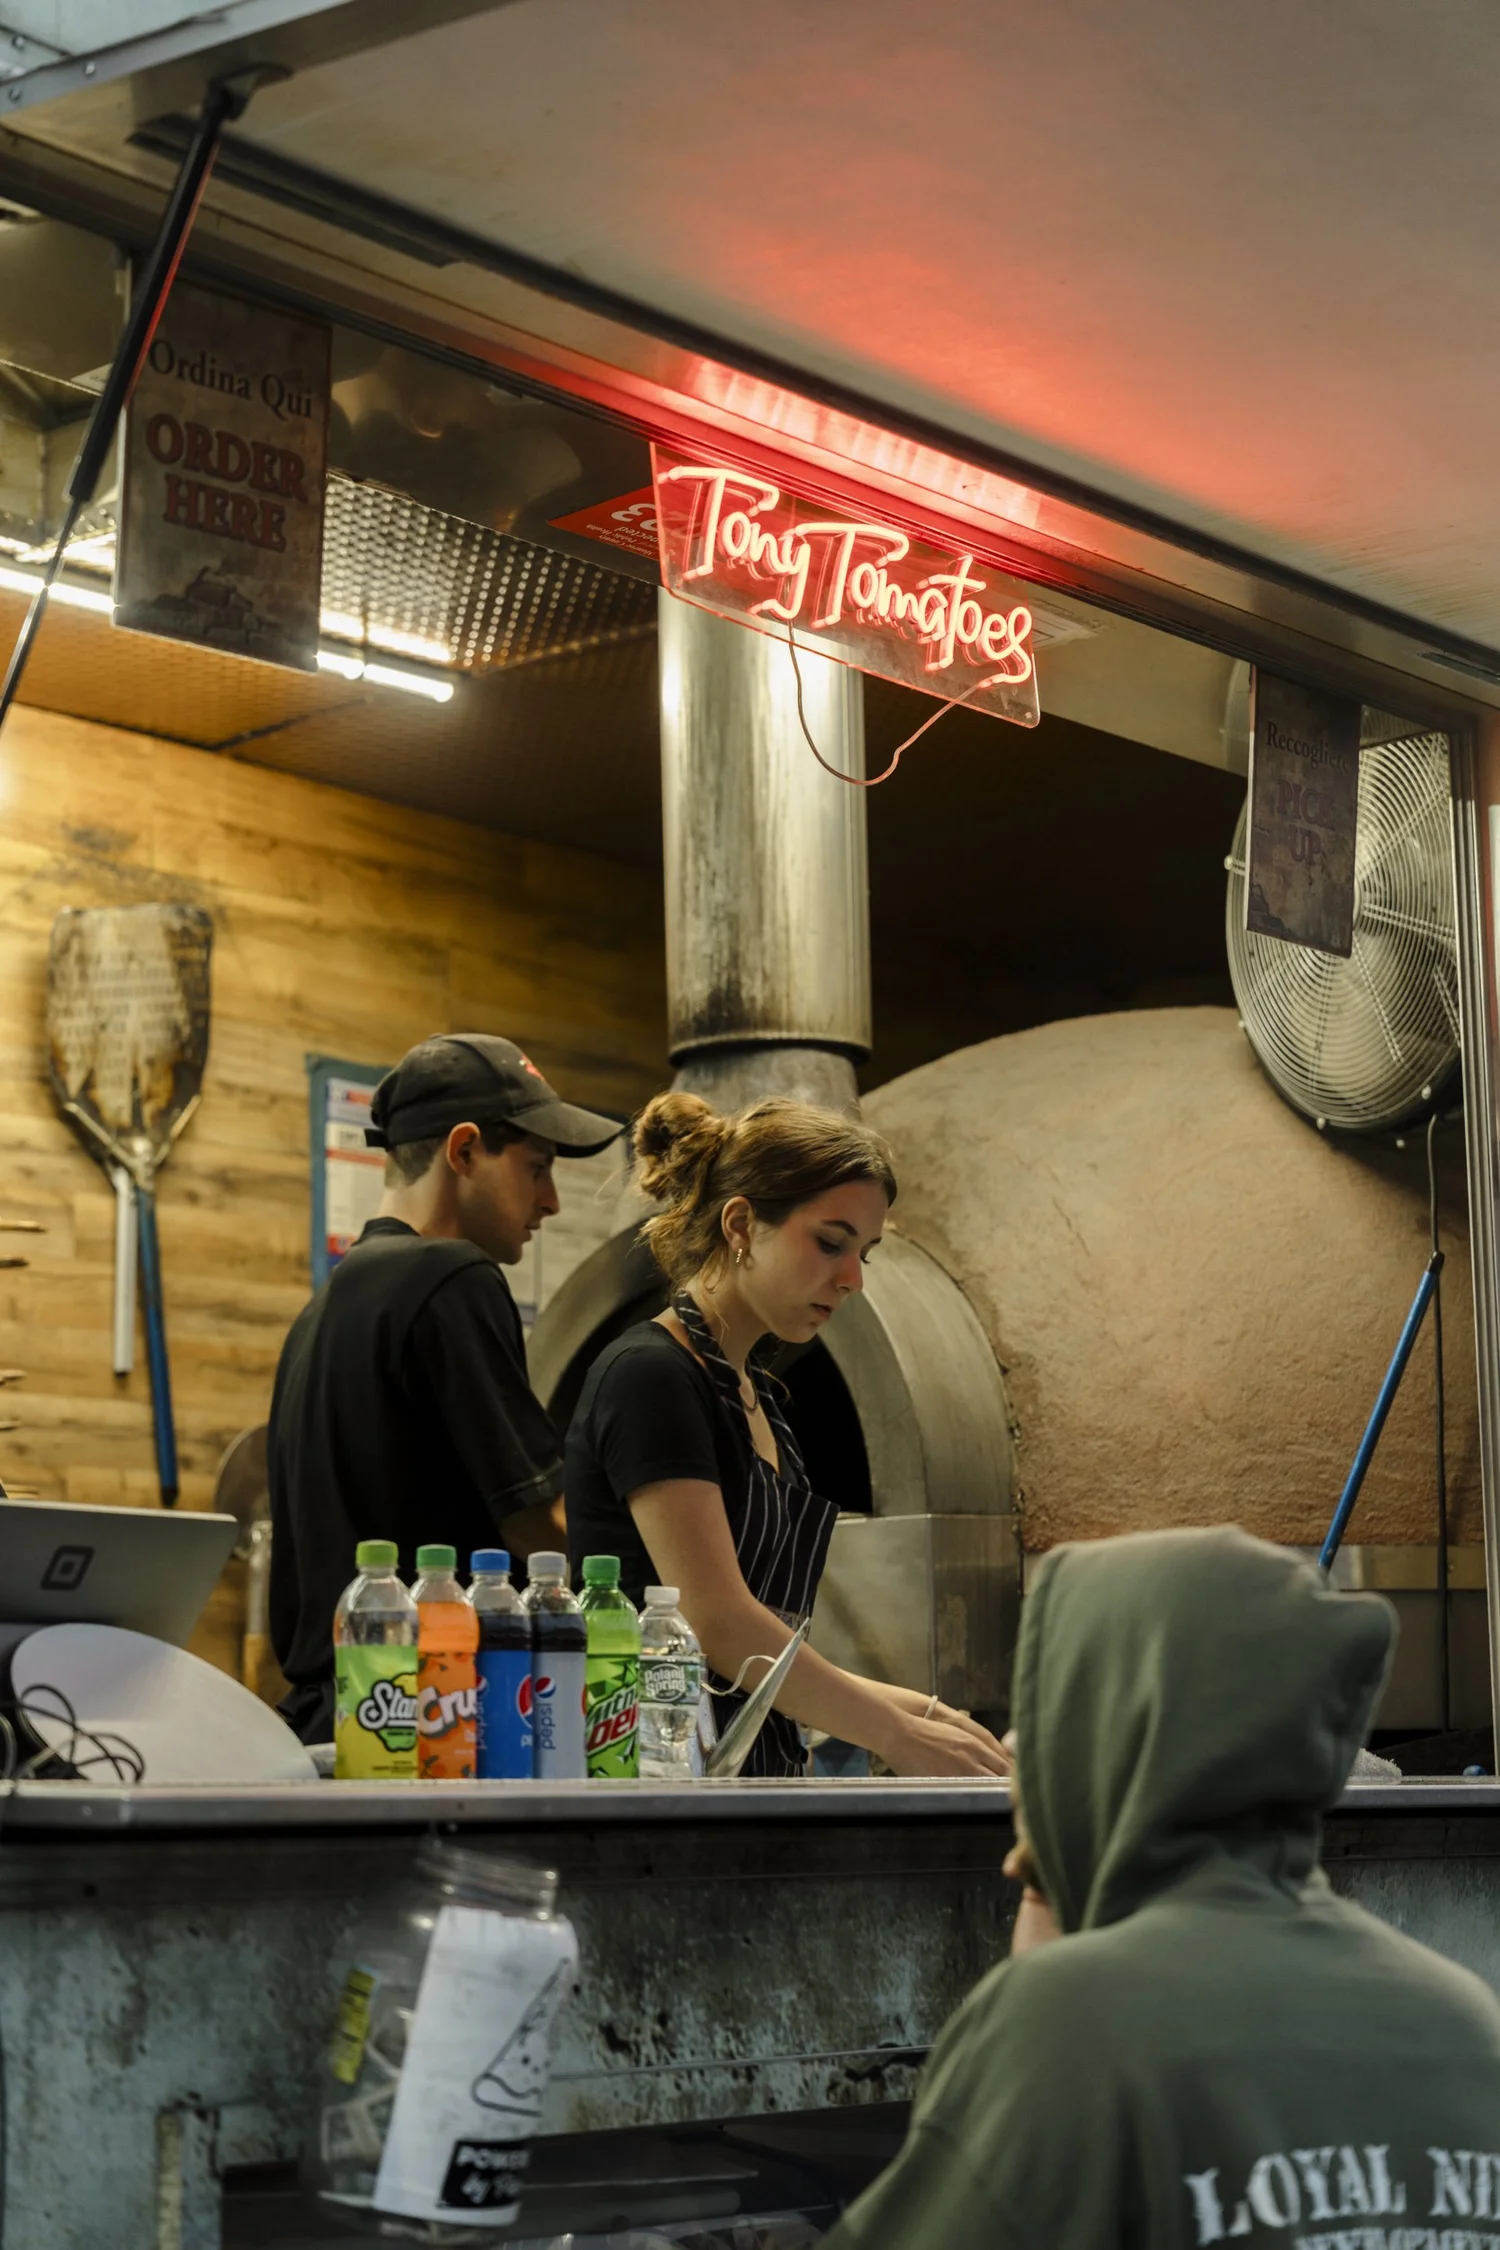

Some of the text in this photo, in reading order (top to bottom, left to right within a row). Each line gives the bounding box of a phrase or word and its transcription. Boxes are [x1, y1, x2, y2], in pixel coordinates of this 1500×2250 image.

[150, 338, 313, 421] Ordina Qui
[146, 412, 309, 503] ORDER
[162, 473, 287, 552] HERE
[658, 465, 1034, 688] Tony Tomatoes
[1277, 779, 1337, 831] PICK
[1289, 823, 1324, 867] UP
[645, 1666, 684, 1683] Poland
[646, 1679, 685, 1698] Spring
[540, 1703, 556, 1750] pepsi
[1183, 2144, 1407, 2247] LOYAL
